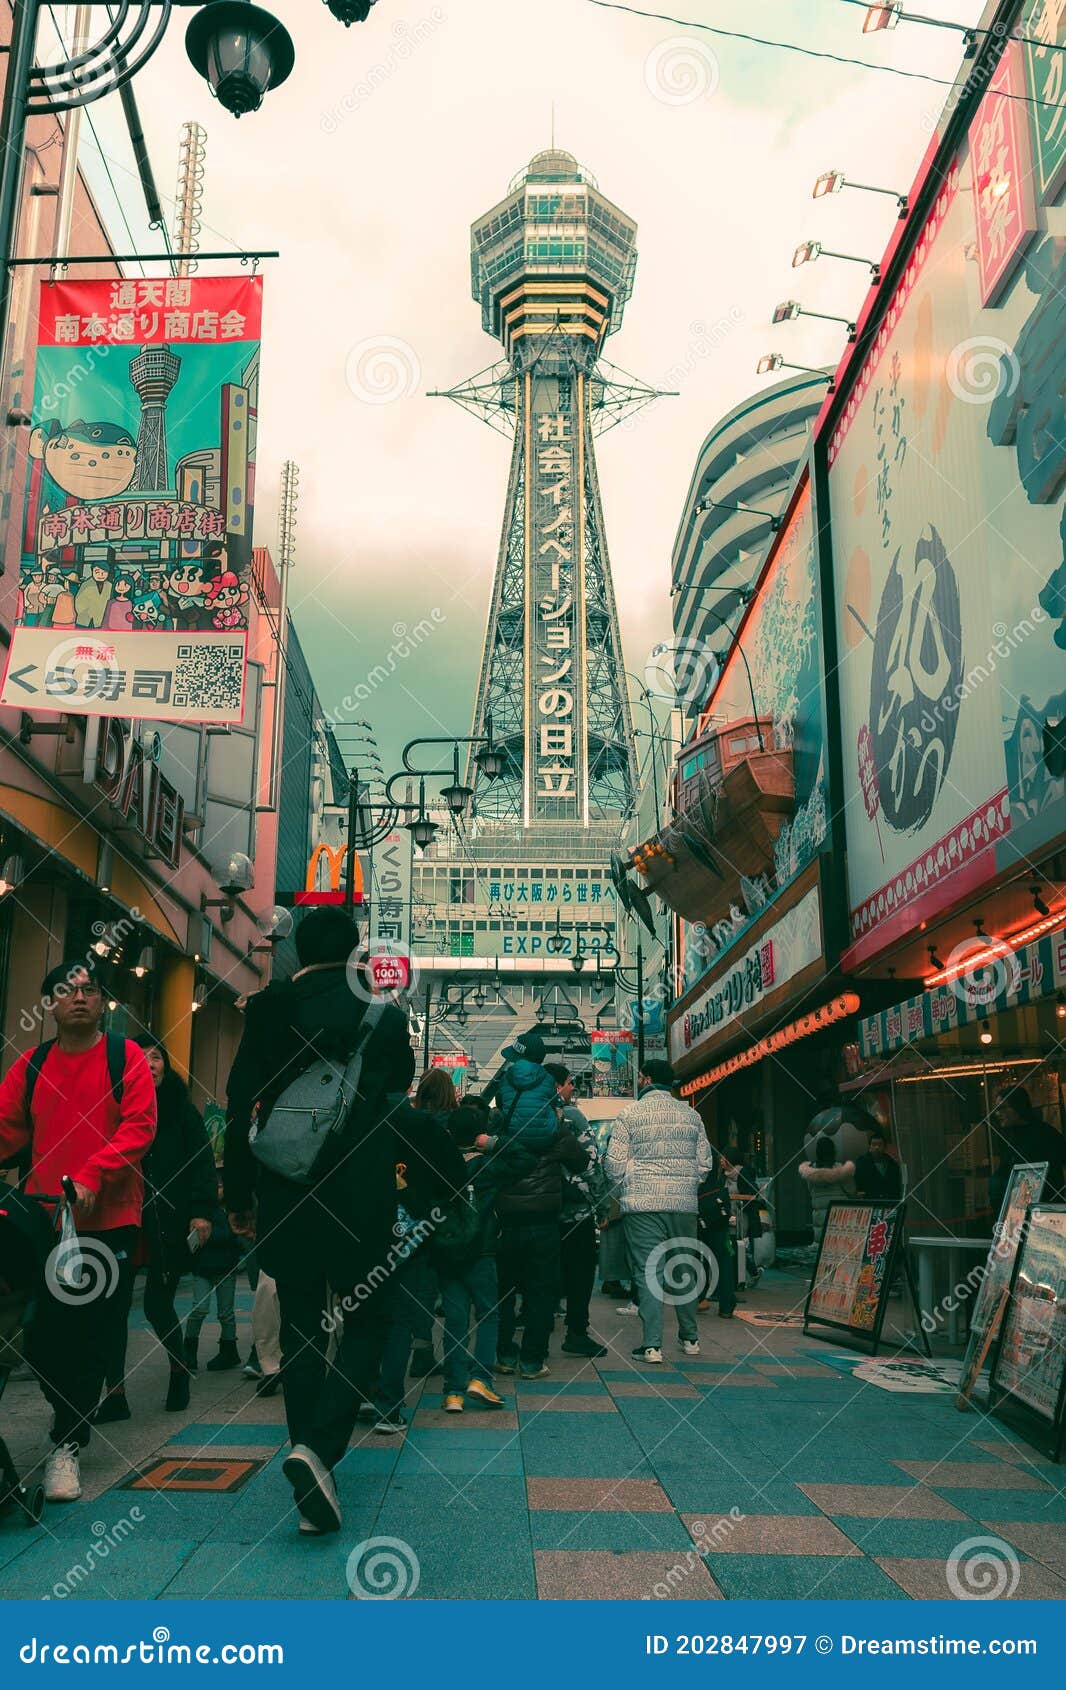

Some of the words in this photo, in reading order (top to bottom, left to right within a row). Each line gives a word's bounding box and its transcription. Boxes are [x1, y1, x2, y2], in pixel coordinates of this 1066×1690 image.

[110, 280, 191, 309] 通天閣
[55, 310, 246, 343] 南本通り商店会
[43, 504, 226, 538] 南本通り商店街
[537, 414, 576, 798] 社会イノベーションの日立
[74, 644, 117, 661] 無添
[8, 663, 174, 705] くら寿司
[378, 846, 403, 944] くら寿司
[489, 882, 616, 903] 再び大阪から世界へ
